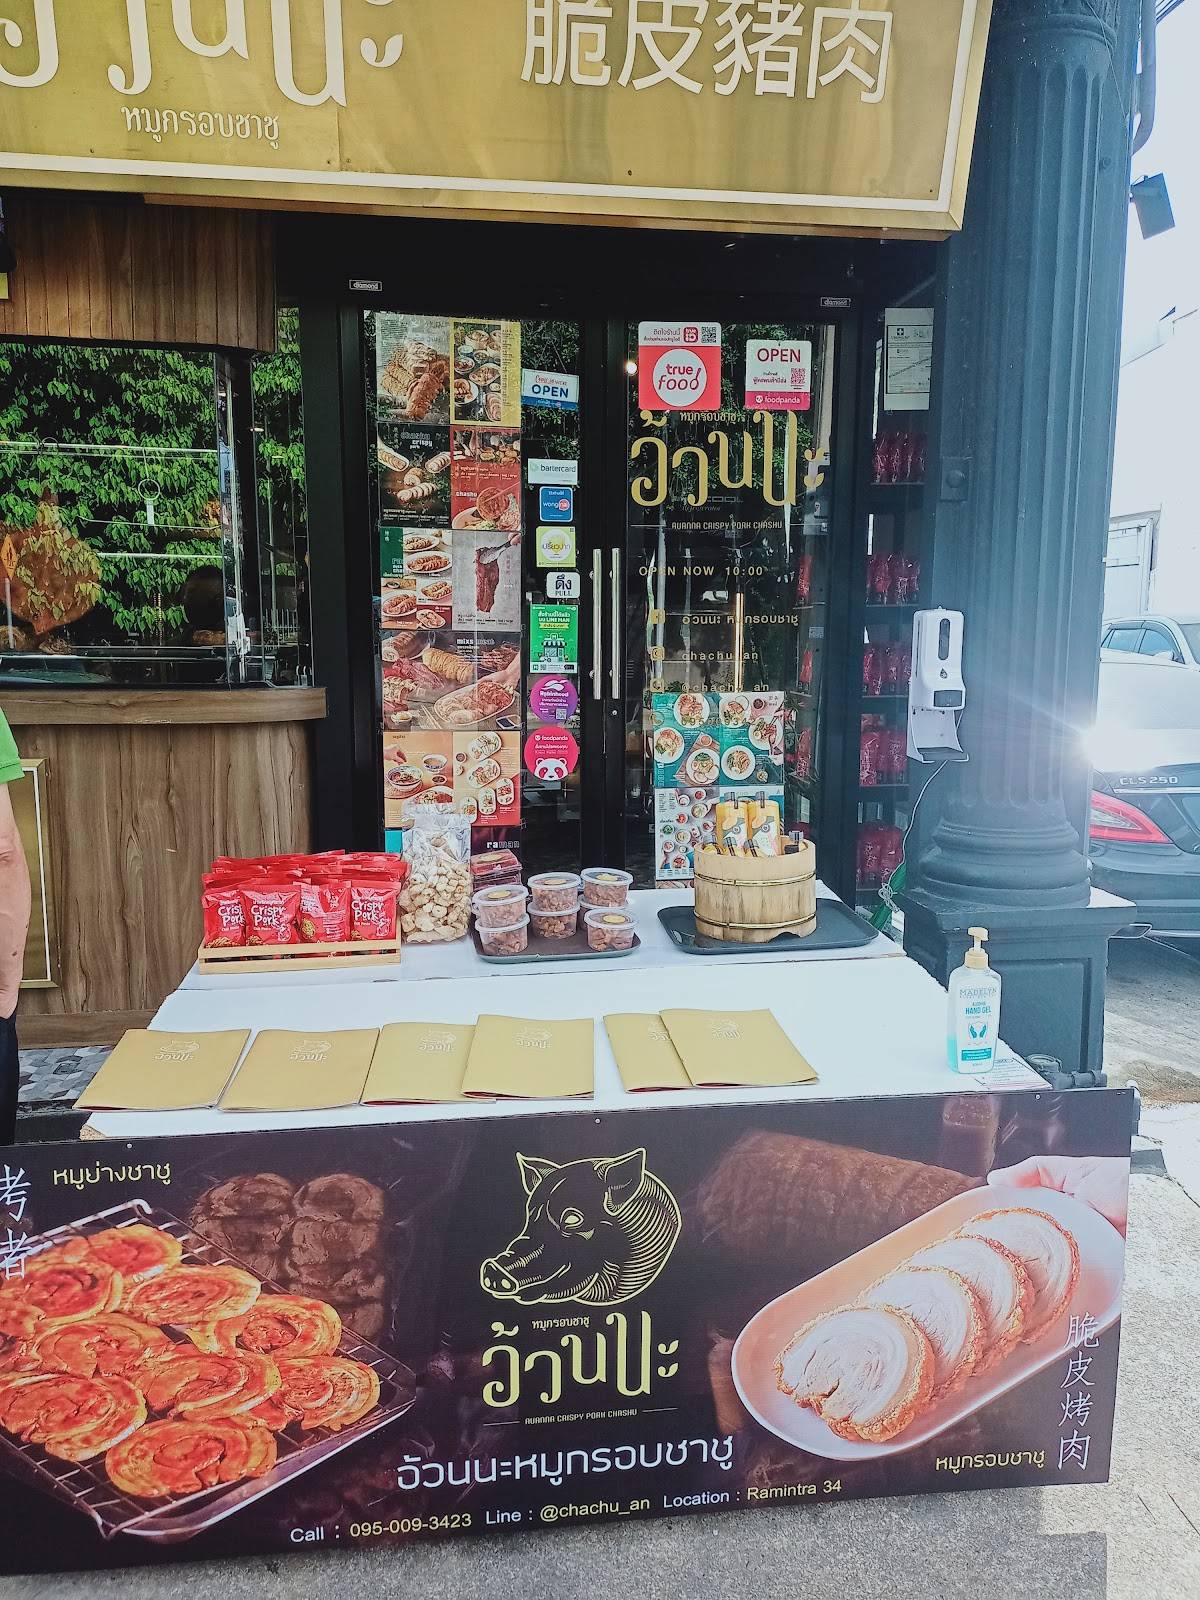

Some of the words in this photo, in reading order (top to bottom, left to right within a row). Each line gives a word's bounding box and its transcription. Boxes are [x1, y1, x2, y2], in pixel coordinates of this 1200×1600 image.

[519, 0, 894, 105] 脆皮豬肉
[121, 105, 280, 149] หมูกรอบชาชู
[353, 281, 379, 290] diamond
[757, 347, 801, 363] OPEN
[665, 363, 693, 375] true
[657, 367, 702, 391] food
[531, 383, 569, 399] OPEN
[764, 395, 801, 405] foodpanda
[412, 439, 433, 448] crispy
[540, 463, 576, 473] bartercard
[703, 521, 729, 530] CRISPY
[731, 521, 752, 530] PORK
[754, 521, 783, 529] CHASHU
[639, 566, 676, 576] OPEN
[683, 566, 714, 576] NOW
[725, 566, 763, 576] 10:00
[555, 574, 572, 590] ดึง
[727, 614, 799, 627] หกรอบชาชู
[539, 690, 570, 698] Robinhood
[1120, 775, 1147, 785] CLS
[1149, 775, 1179, 785] 250
[251, 905, 286, 917] Crispy
[351, 901, 384, 912] Crispy
[254, 914, 279, 926] Pork
[354, 911, 379, 921] Pork
[965, 1007, 982, 1015] HAND
[982, 1006, 992, 1014] GEL
[53, 1161, 172, 1190] หมูย่างชาชู
[531, 1316, 591, 1332] หมูกรอบชาชู
[1057, 1311, 1100, 1472] 脆皮烤肉
[557, 1413, 584, 1423] CRISPY
[586, 1411, 606, 1421] PORK
[608, 1408, 638, 1419] CHASHU
[935, 1449, 1046, 1474] หมูกรอบชาชู
[289, 1526, 325, 1544] Call
[349, 1513, 473, 1538] 095-009-3423
[485, 1508, 521, 1525] Line
[539, 1497, 651, 1522] @chachu_an
[663, 1489, 730, 1509] Location
[747, 1482, 818, 1501] Ramintra
[823, 1479, 842, 1494] 34
